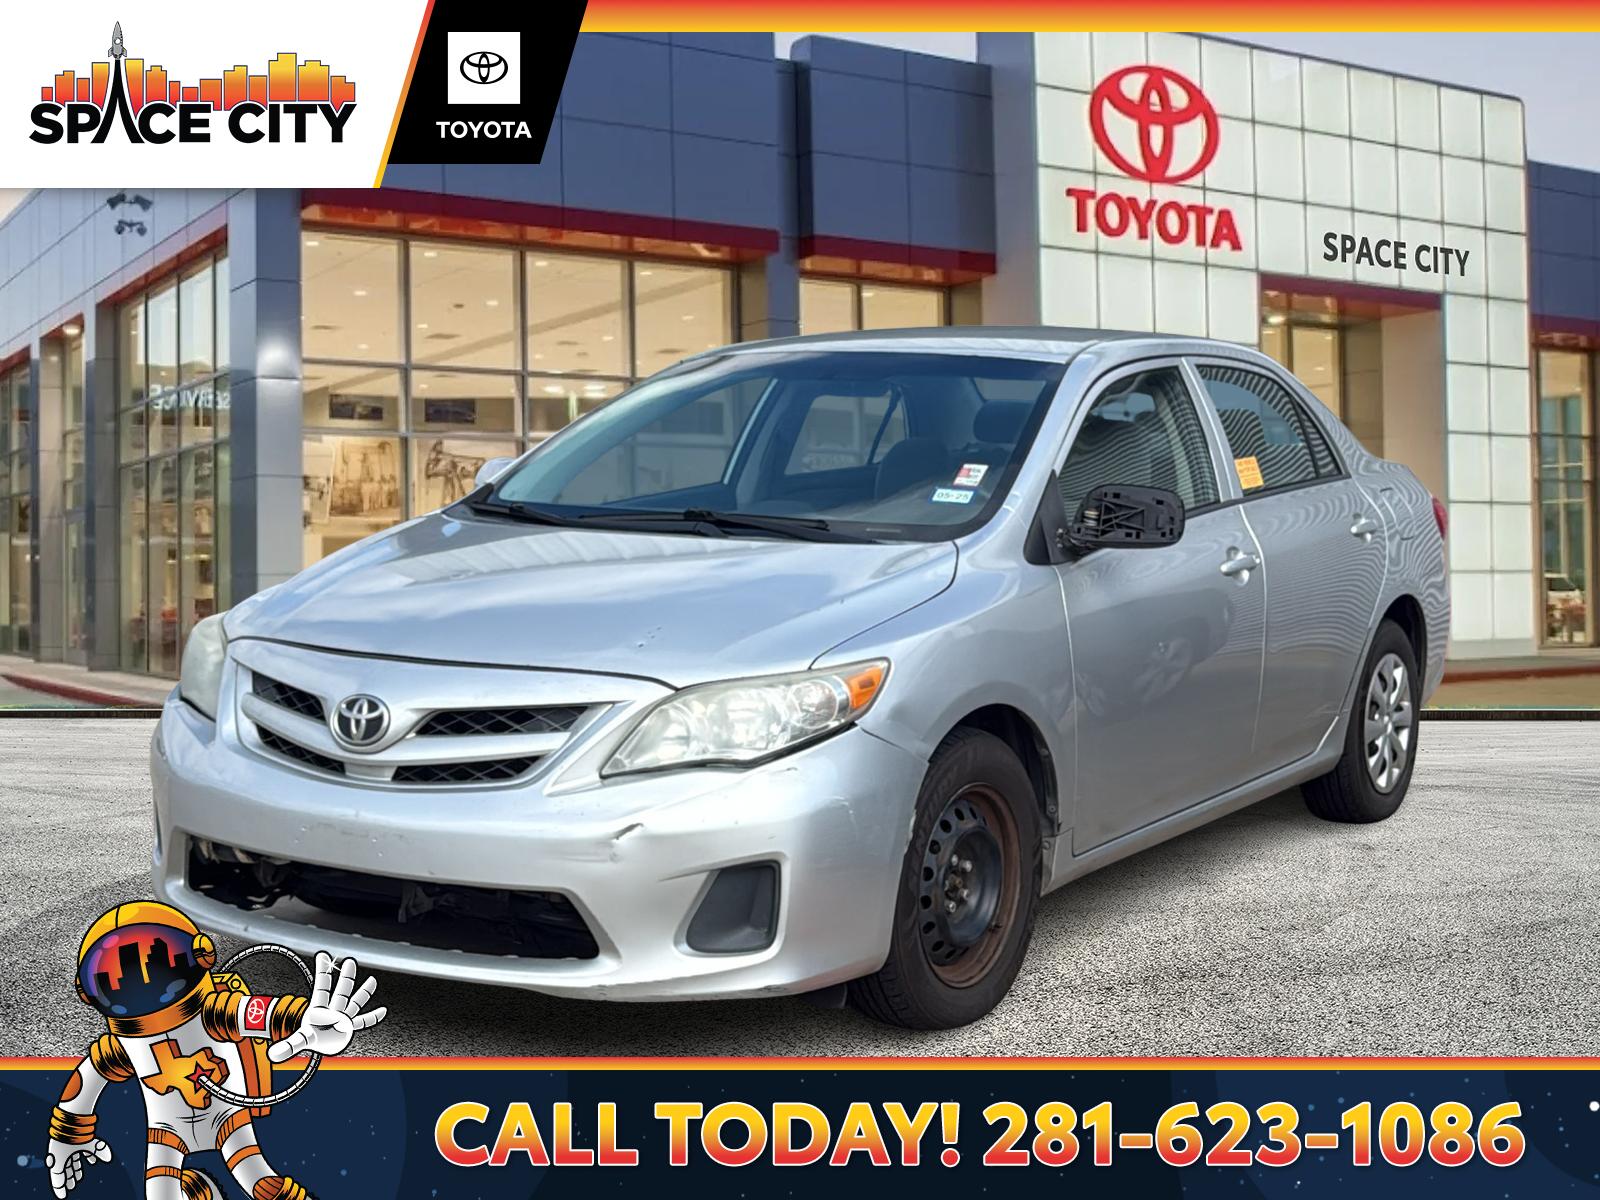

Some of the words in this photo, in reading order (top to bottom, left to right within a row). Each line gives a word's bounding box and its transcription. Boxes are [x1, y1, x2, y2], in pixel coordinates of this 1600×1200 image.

[1065, 188, 1243, 251] TOYOTA
[1322, 232, 1407, 270] SPACE
[1414, 244, 1470, 277] CITY
